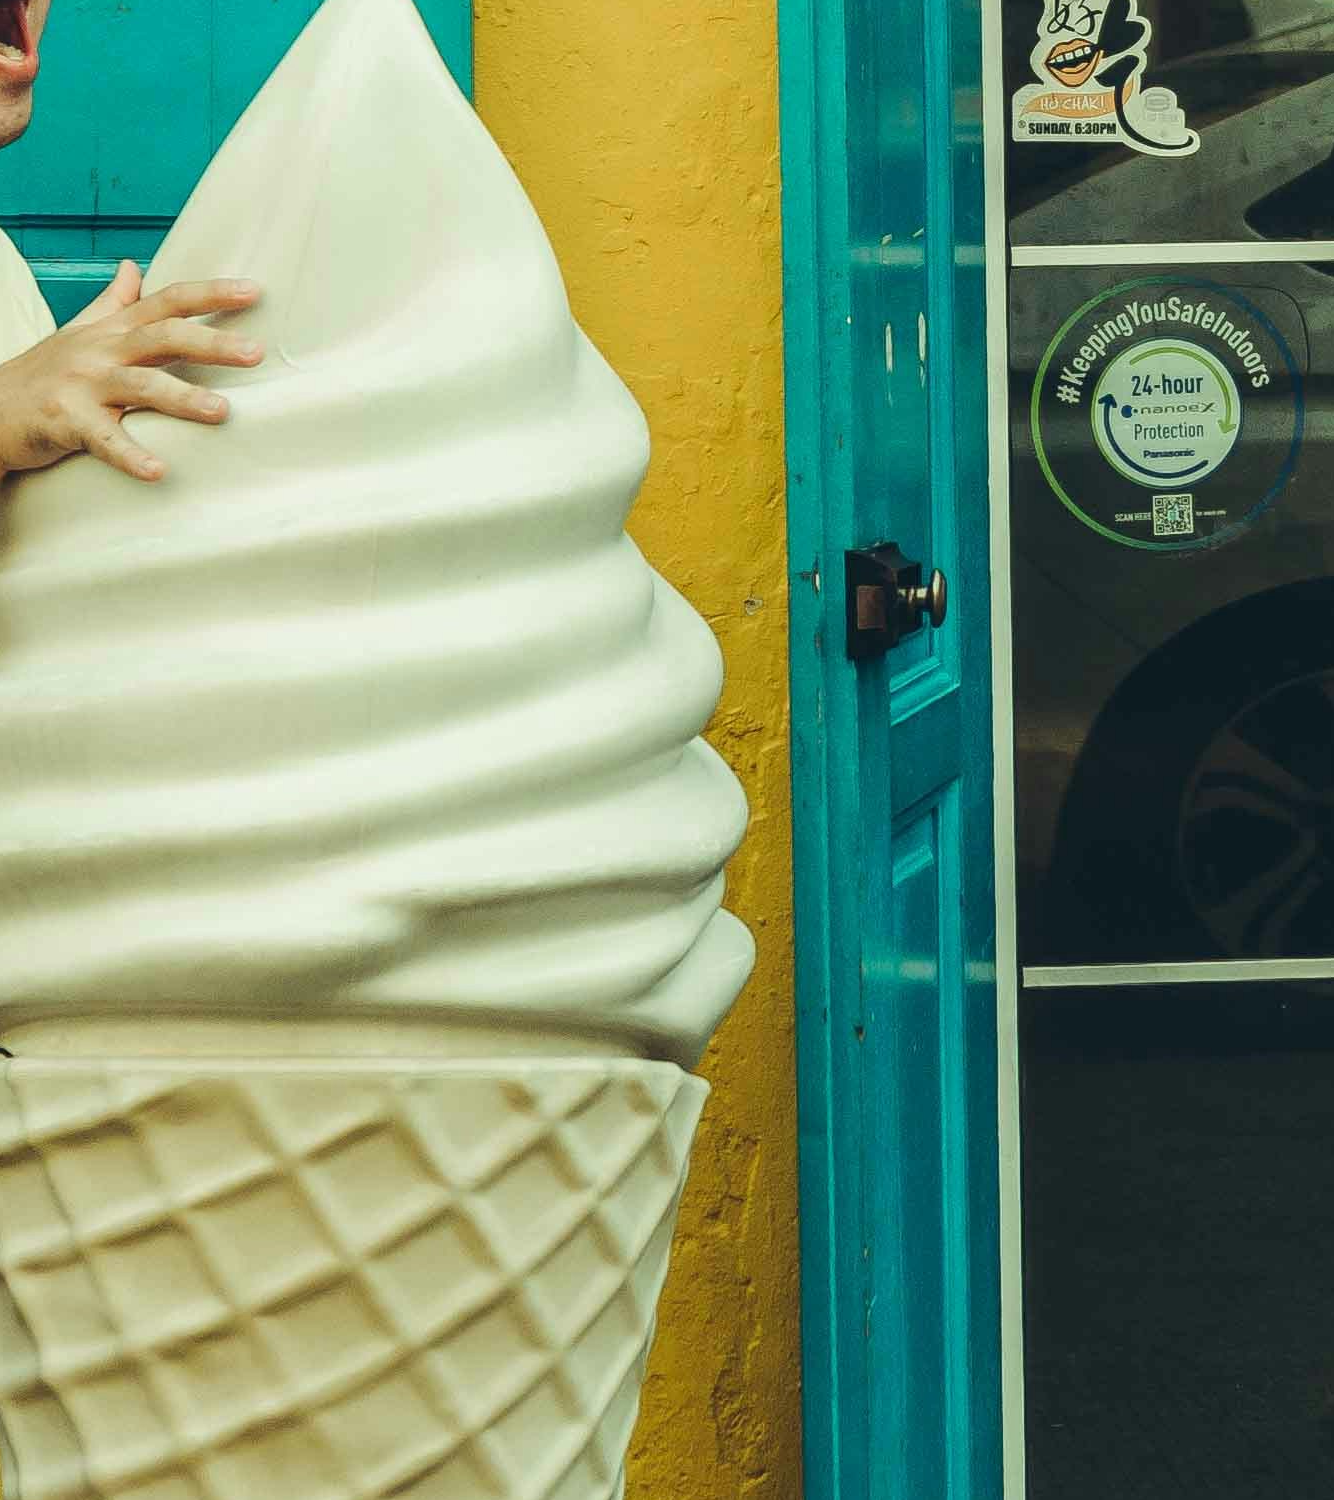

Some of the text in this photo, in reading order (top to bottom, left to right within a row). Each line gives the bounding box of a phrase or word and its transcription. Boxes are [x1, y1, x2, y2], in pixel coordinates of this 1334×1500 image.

[1074, 122, 1117, 135] 6:30PM
[1056, 296, 1270, 405] #KeepingYouSafeIndoors
[1130, 373, 1204, 397] 24-hour
[1134, 421, 1204, 441] Protection
[1143, 448, 1196, 458] Panasonic
